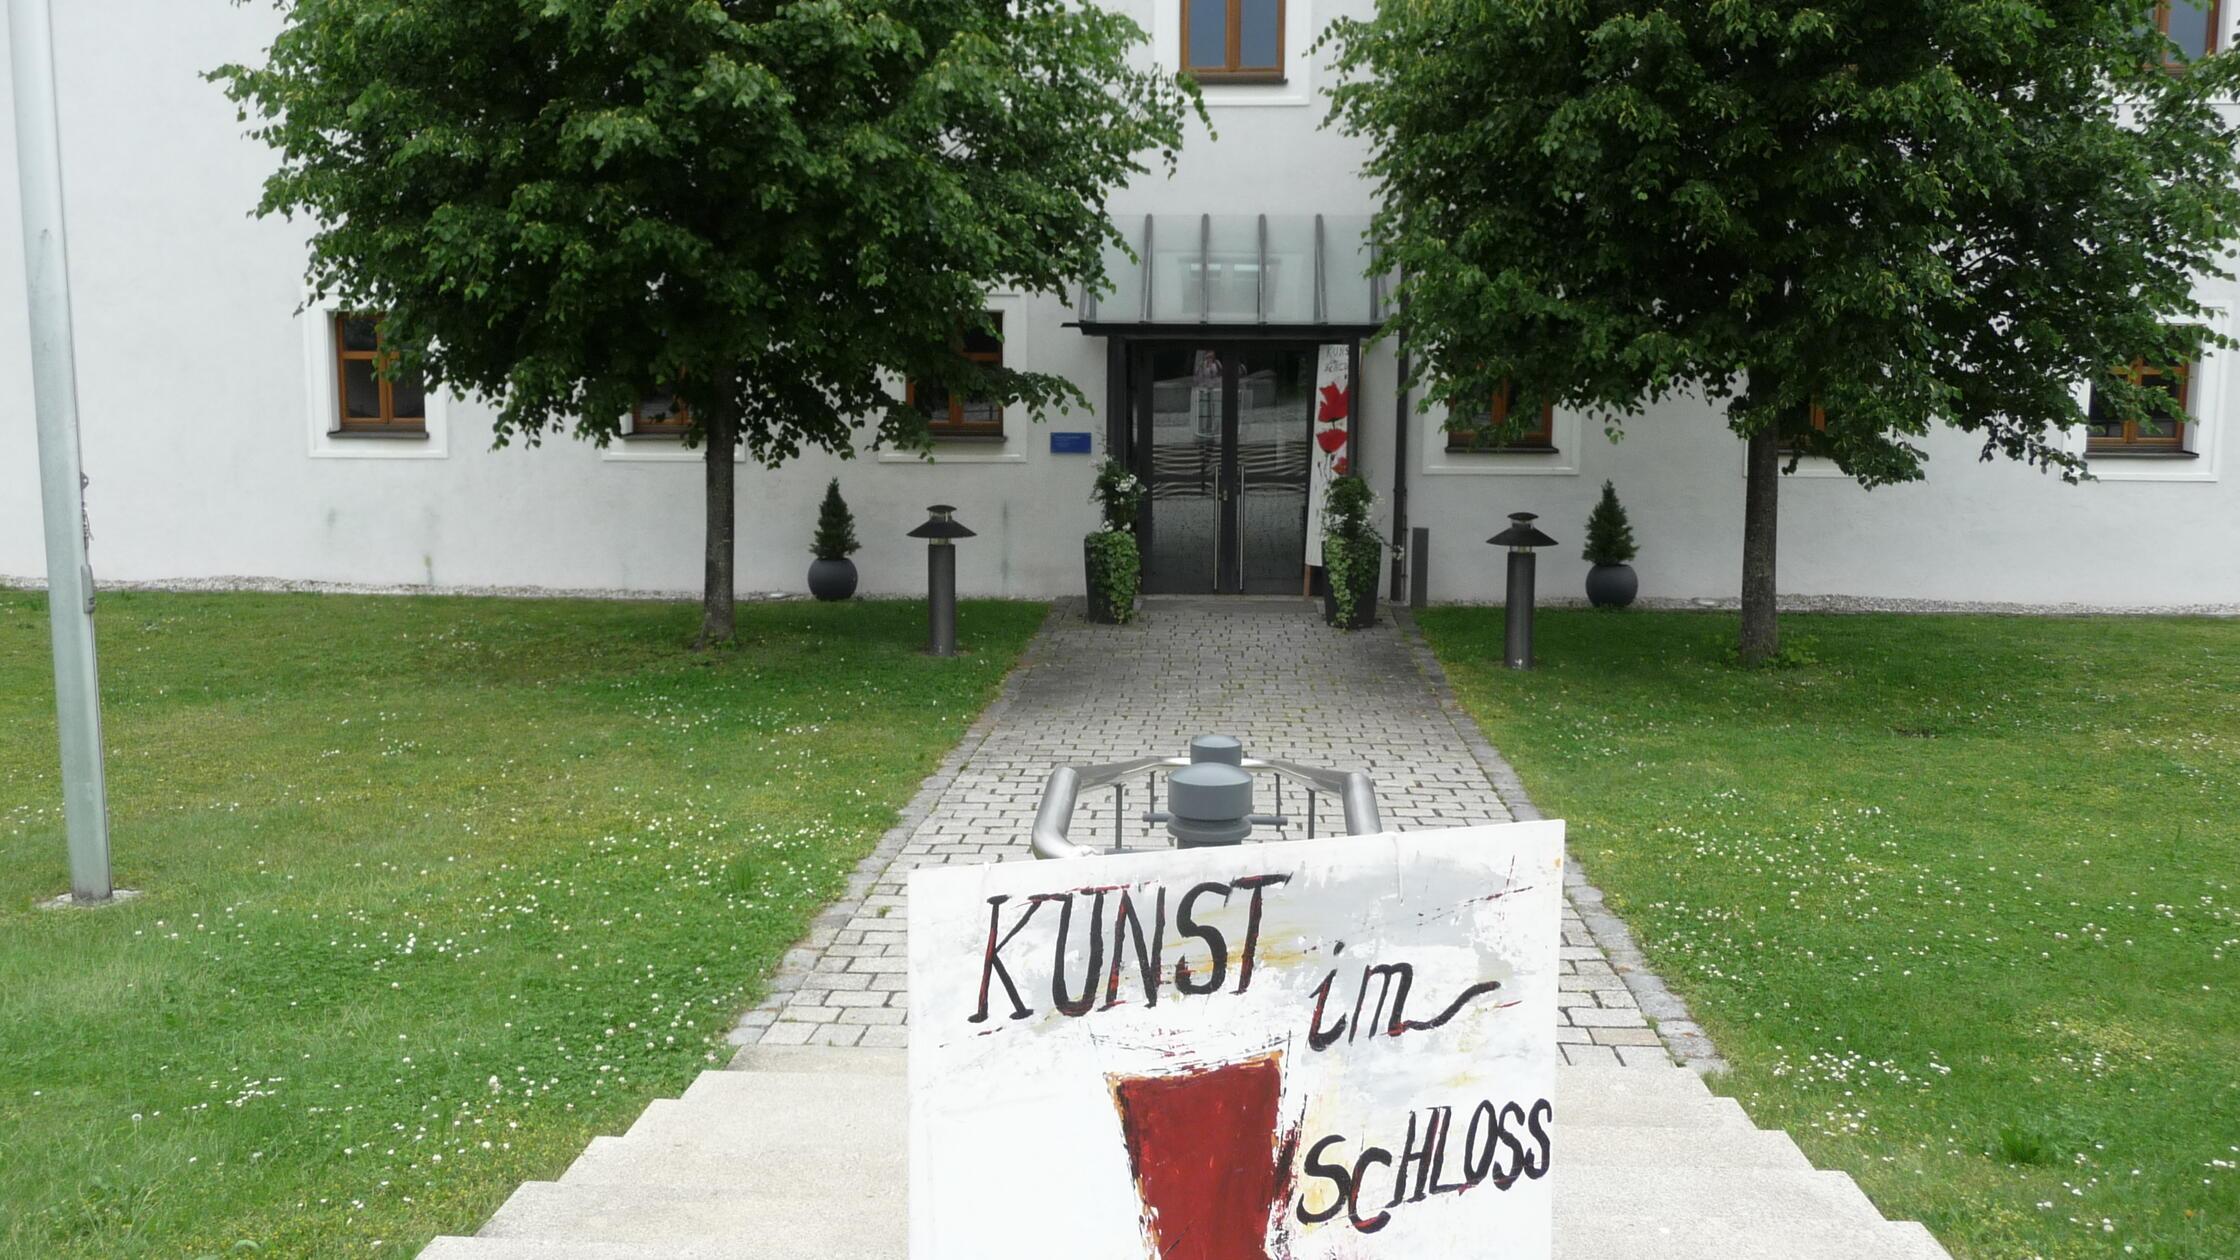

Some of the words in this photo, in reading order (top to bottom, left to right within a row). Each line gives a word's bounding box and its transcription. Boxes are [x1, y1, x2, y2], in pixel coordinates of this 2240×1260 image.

[968, 872, 1293, 1022] KUNST
[1308, 941, 1500, 1051] im
[1296, 1098, 1552, 1233] SCHLOSS
